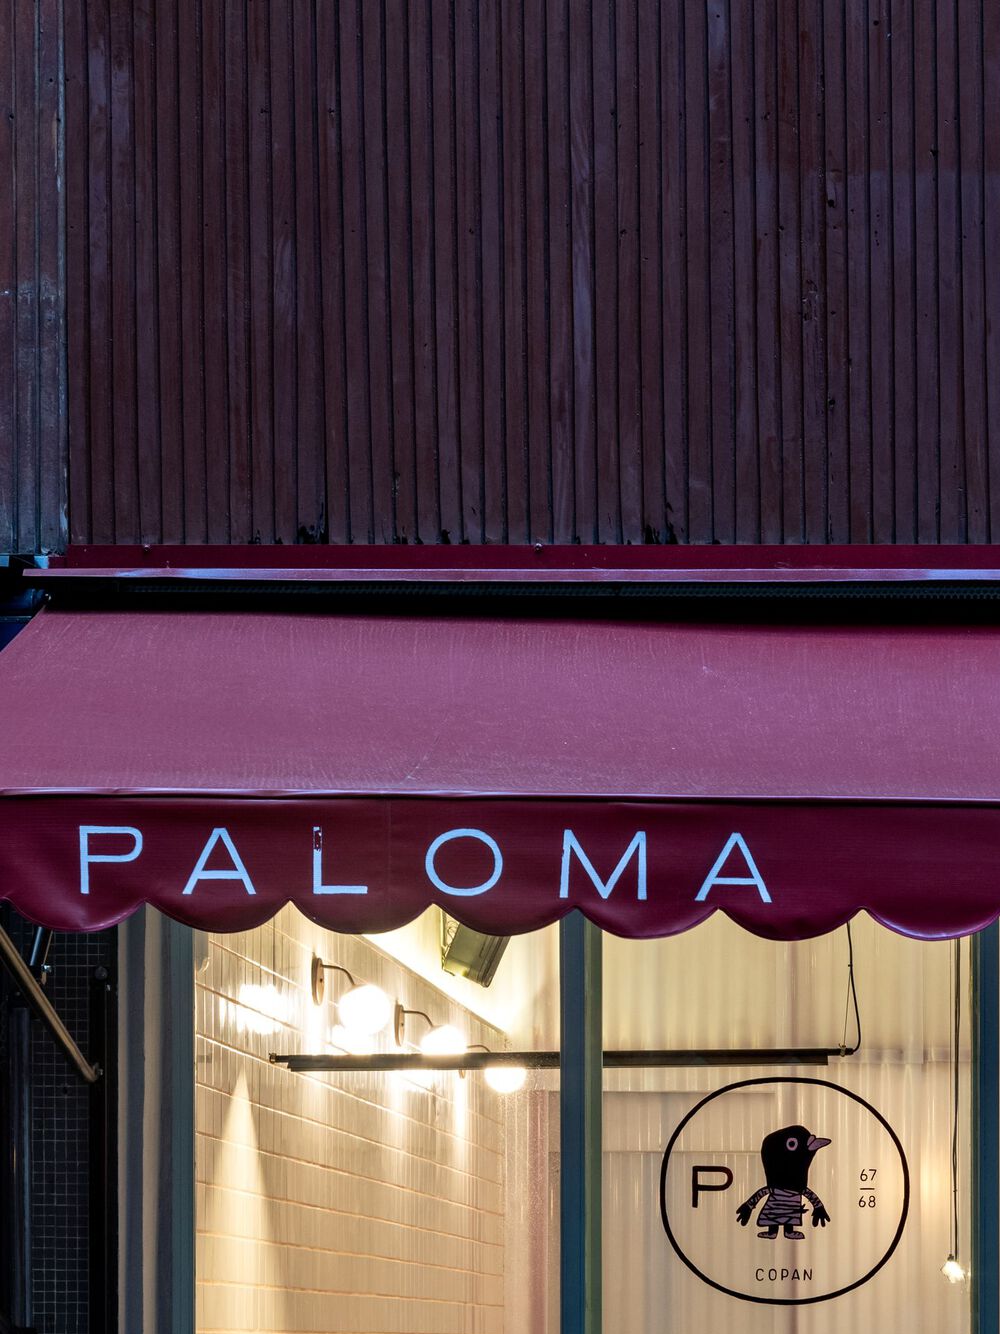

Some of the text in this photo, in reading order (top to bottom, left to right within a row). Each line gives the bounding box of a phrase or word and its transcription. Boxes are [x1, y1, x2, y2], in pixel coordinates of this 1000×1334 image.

[78, 825, 773, 903] PALOMA
[859, 1168, 877, 1182] 67
[691, 1165, 734, 1208] P
[858, 1195, 876, 1208] 68
[755, 1268, 813, 1282] COPAN
